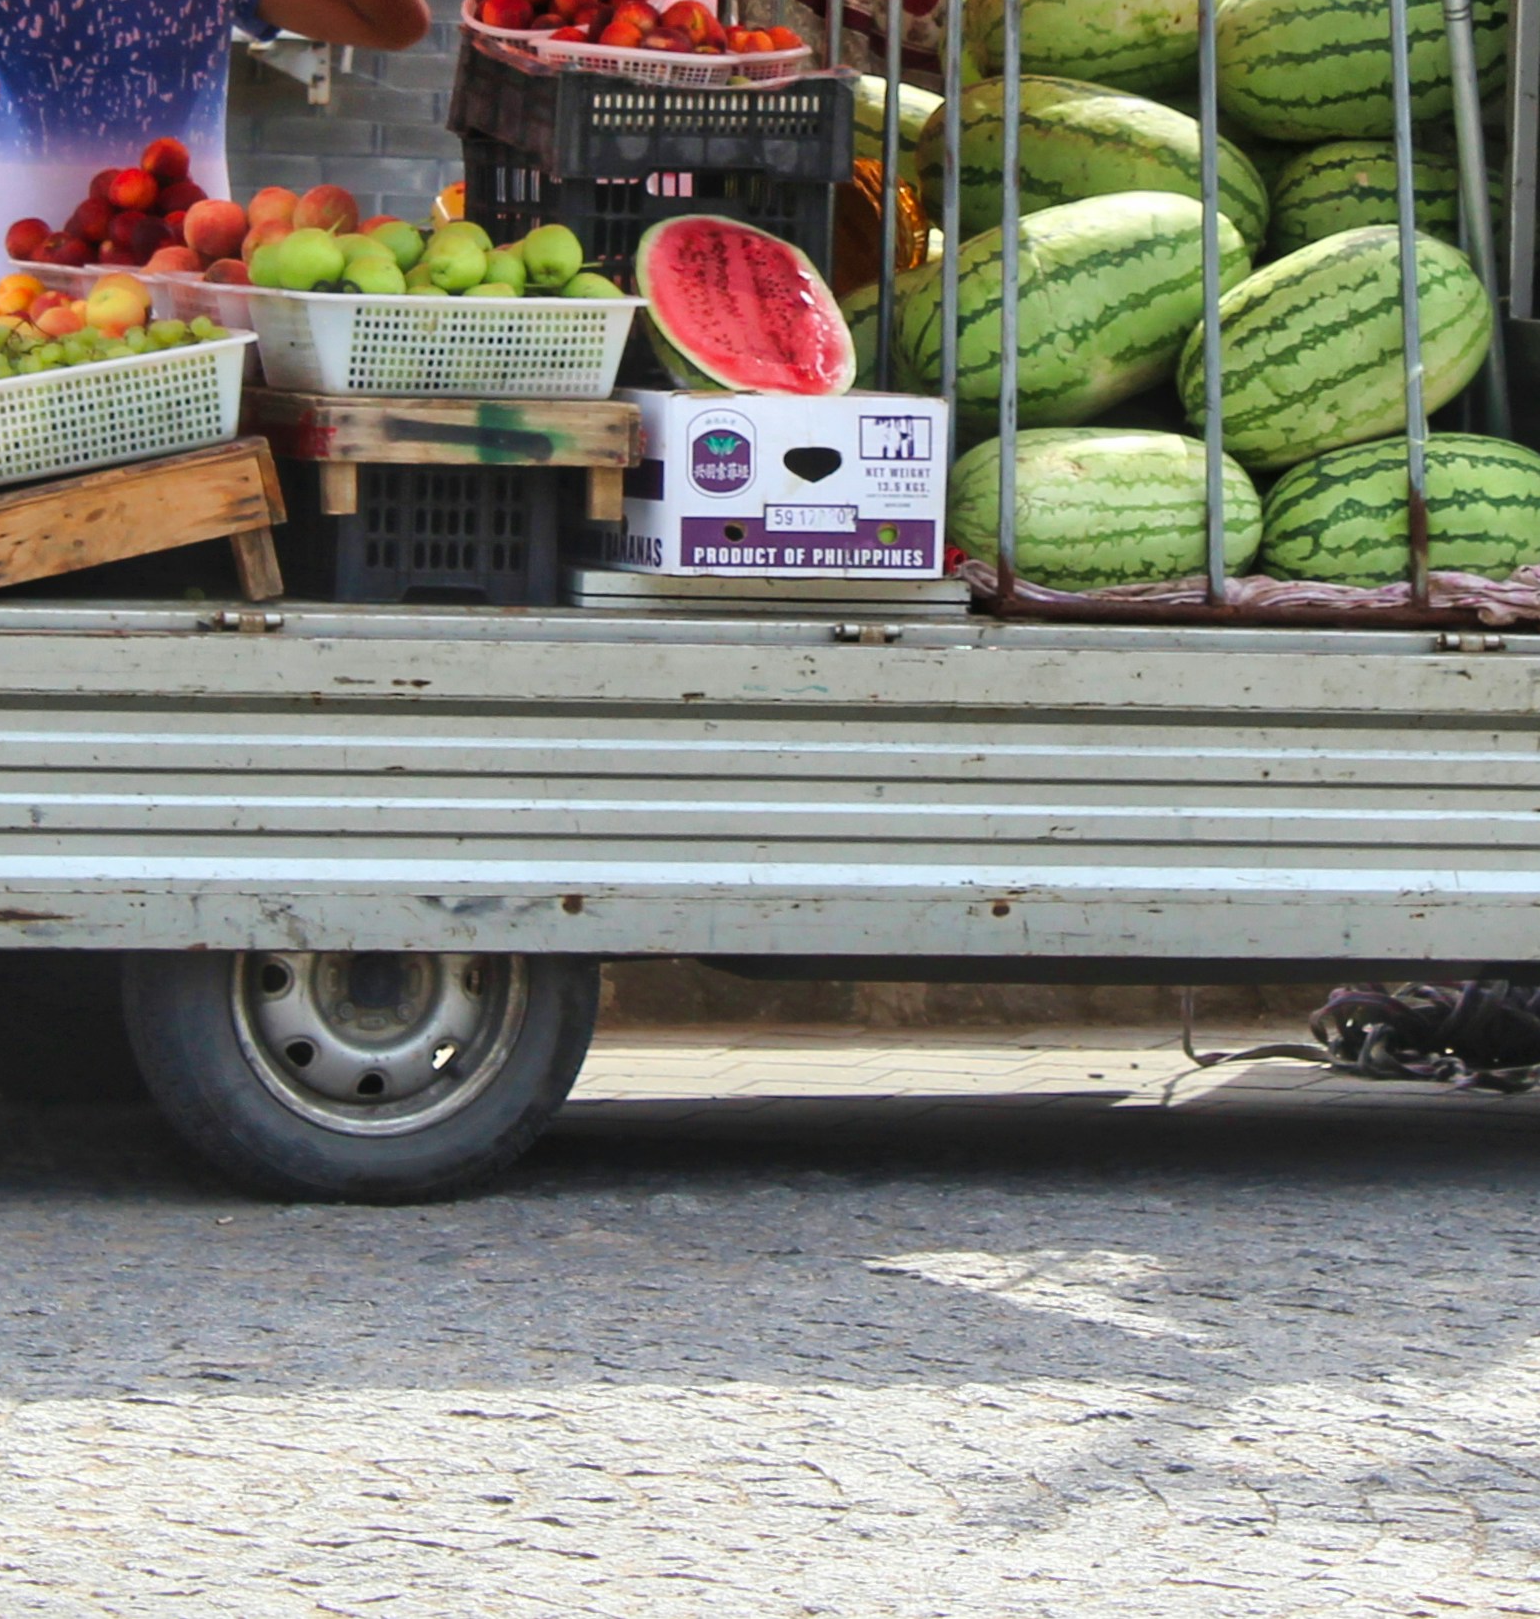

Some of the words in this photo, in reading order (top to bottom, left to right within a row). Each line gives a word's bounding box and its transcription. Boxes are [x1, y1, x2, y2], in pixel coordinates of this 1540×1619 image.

[865, 467, 885, 478] NET
[889, 467, 931, 479] WEIGHT
[693, 547, 778, 565] PRODUCT
[783, 548, 806, 566] OF
[812, 548, 924, 567] PHILIPPINES
